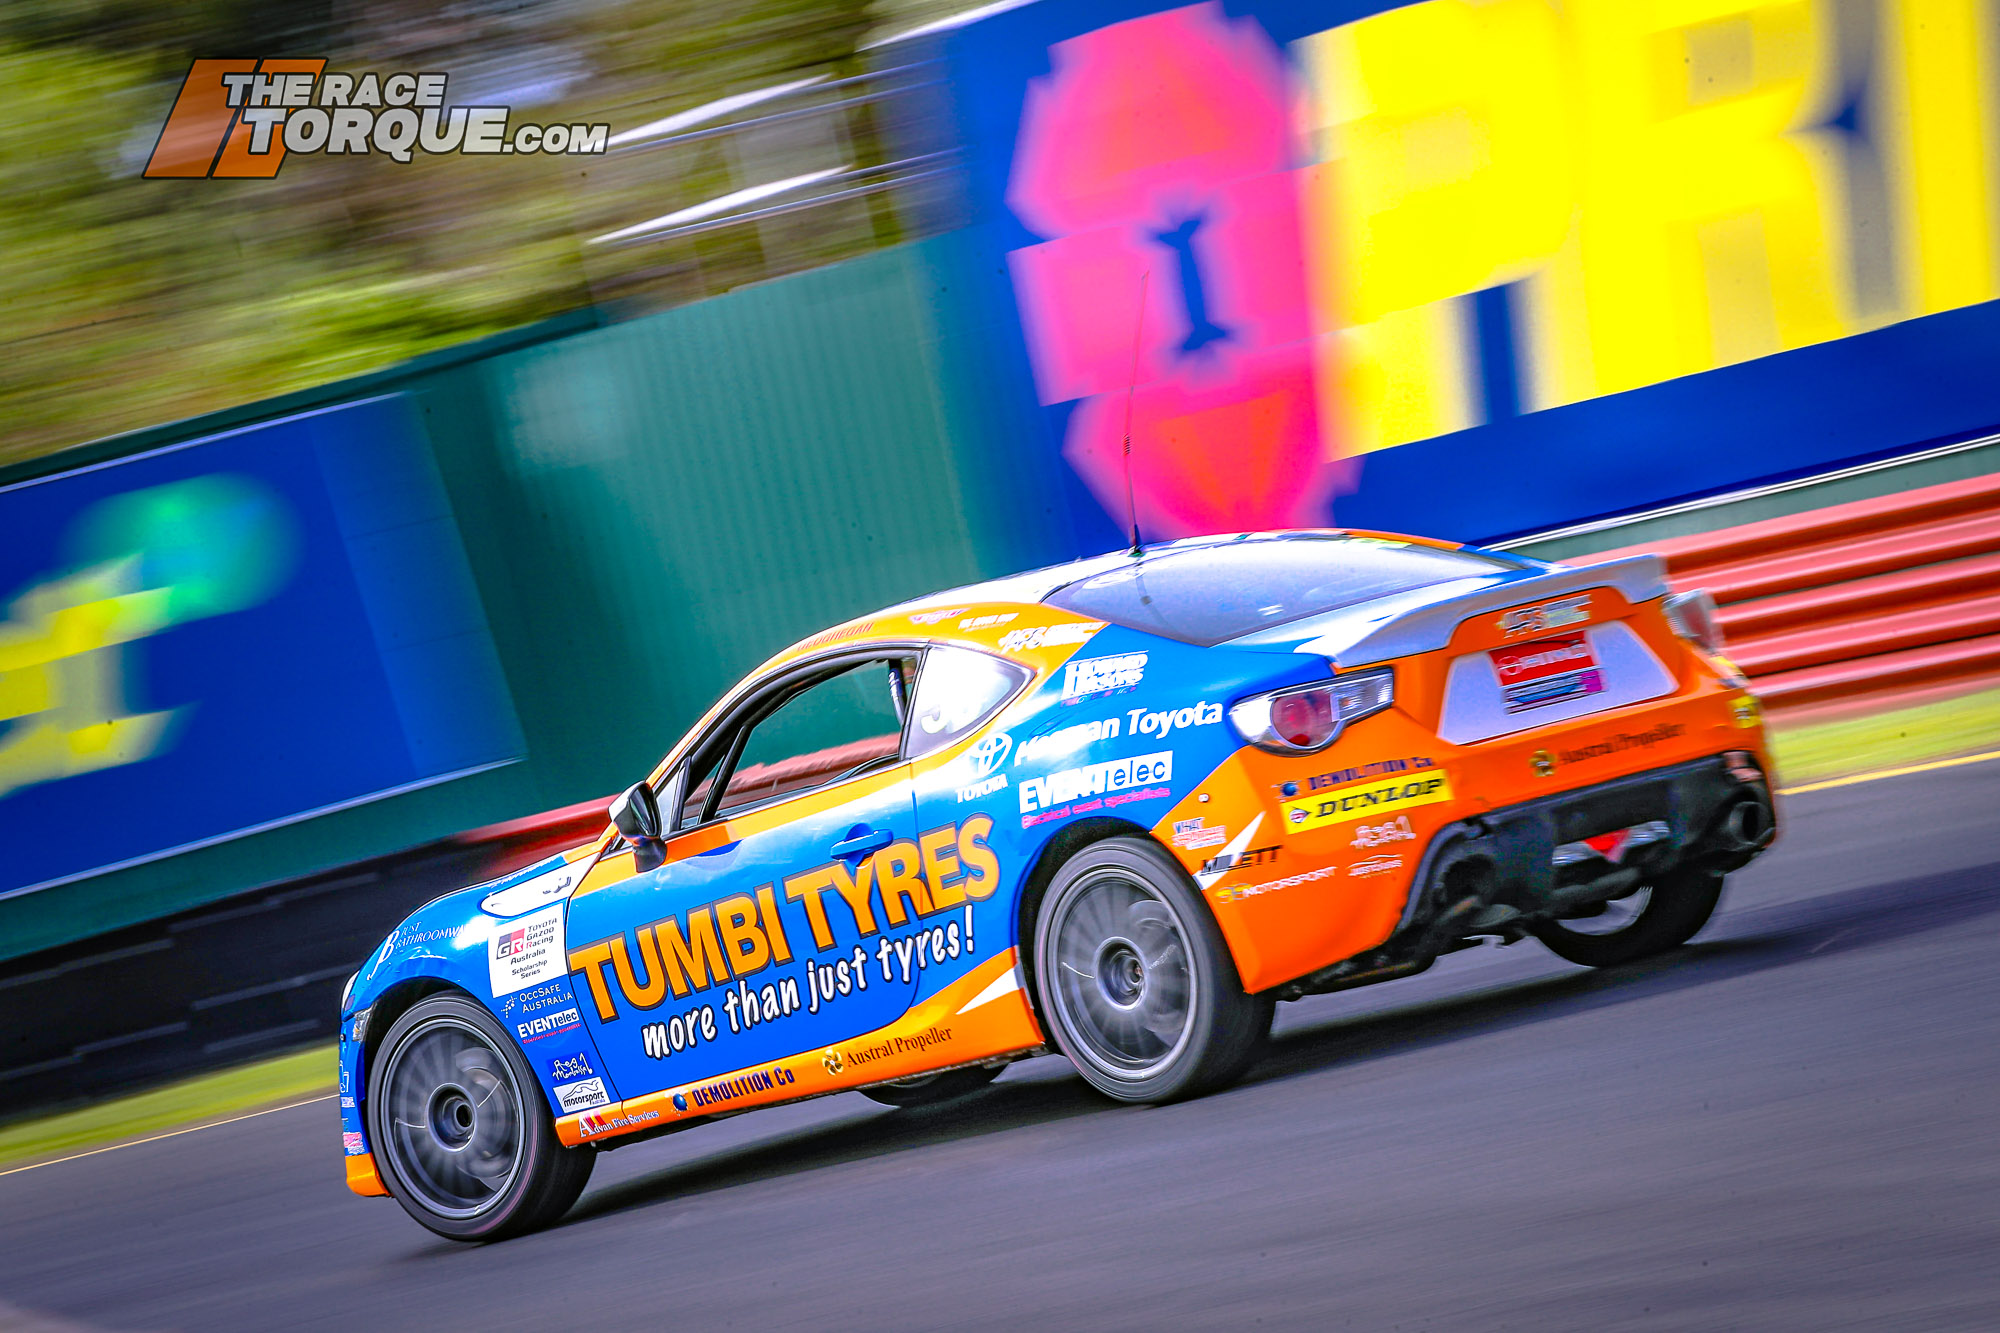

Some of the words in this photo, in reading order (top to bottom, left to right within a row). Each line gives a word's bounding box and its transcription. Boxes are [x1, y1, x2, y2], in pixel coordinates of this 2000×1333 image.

[1126, 700, 1223, 740] Toyota
[955, 773, 1008, 804] TOYOTA
[1316, 778, 1443, 818] DUNLOP
[528, 917, 557, 933] TOYOTA
[566, 882, 793, 1025] TUMBI
[782, 813, 1002, 952] TYRES
[526, 926, 555, 941] GAZOO
[526, 935, 554, 949] Racing
[496, 936, 525, 960] GR
[510, 948, 546, 965] Australia
[511, 959, 548, 976] Scholarship
[520, 968, 541, 979] Series
[642, 1007, 718, 1062] more
[726, 972, 802, 1035] than
[806, 947, 867, 1014] just
[875, 905, 976, 986] tyres!
[522, 992, 573, 1013] AUSTRALIA
[517, 1008, 580, 1039] EVENTelec
[846, 1041, 895, 1068] Austral
[897, 1026, 954, 1055] Propeller
[691, 1071, 774, 1107] DEMOLITION
[776, 1066, 795, 1086] Co
[563, 1091, 605, 1108] motorsport
[613, 1116, 630, 1129] Fire
[629, 1109, 660, 1125] Services
